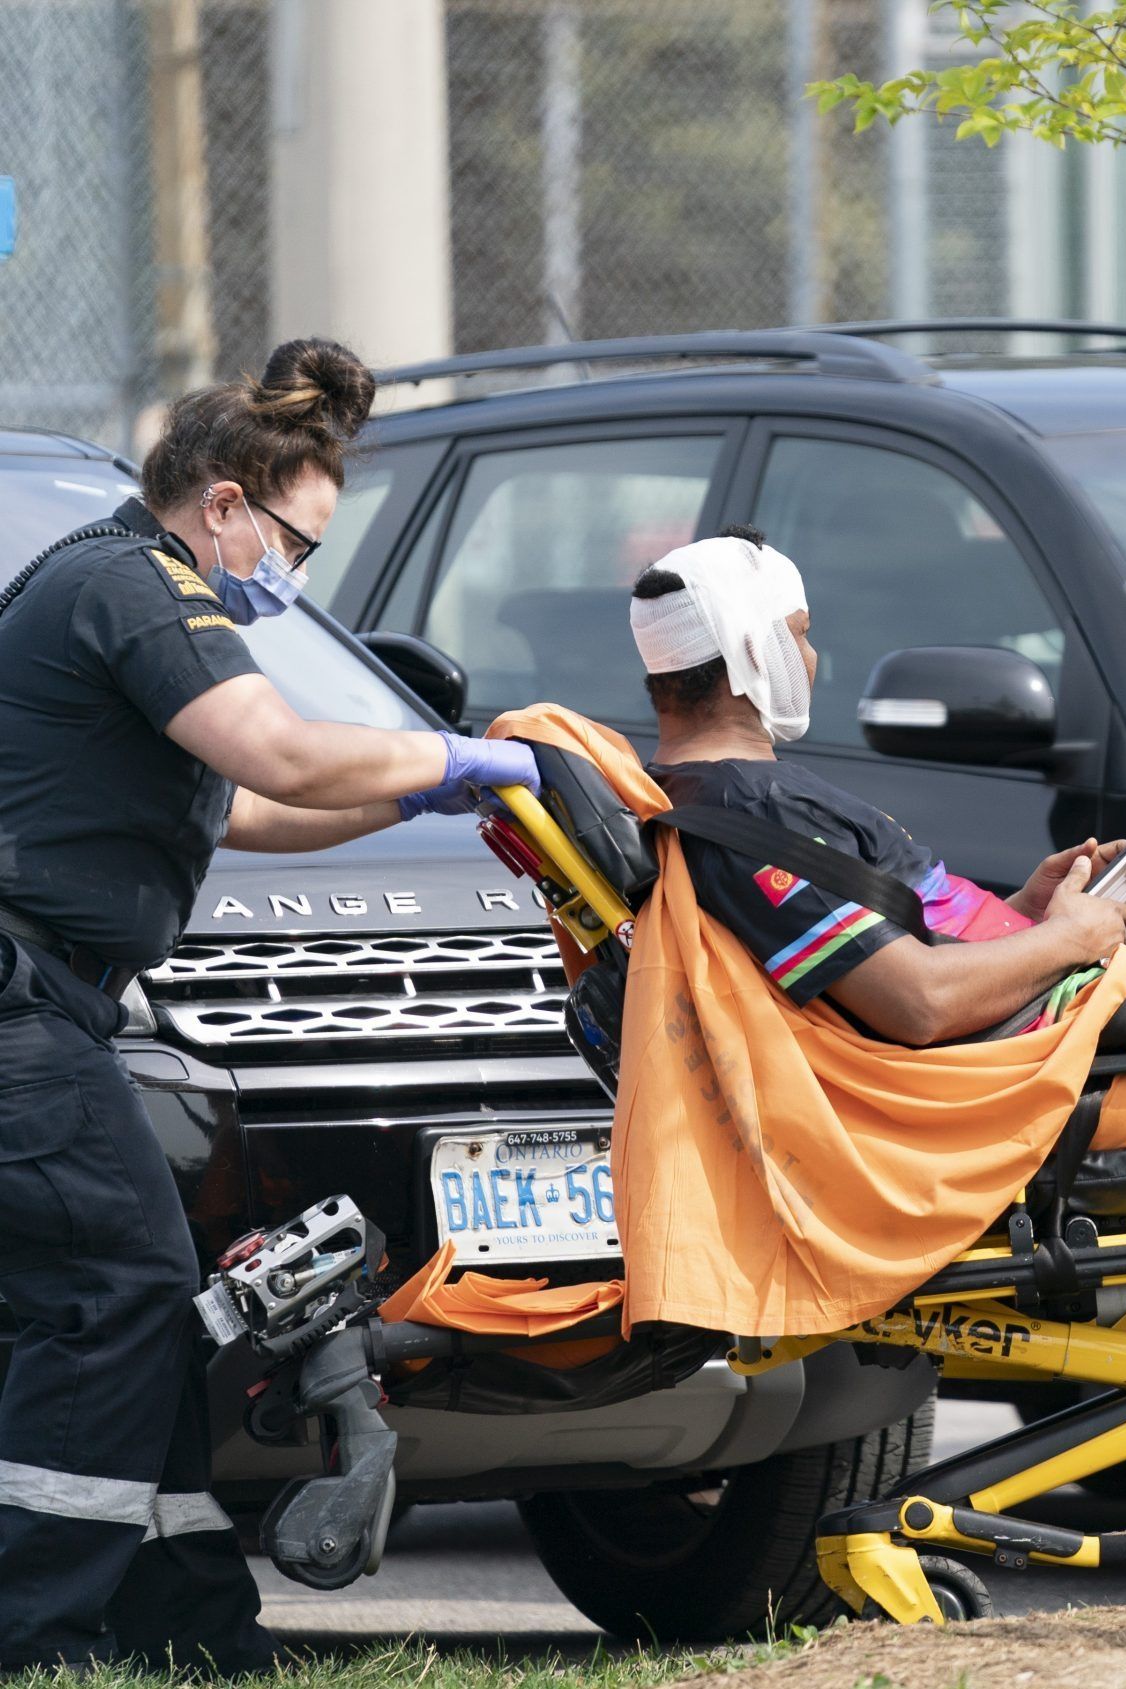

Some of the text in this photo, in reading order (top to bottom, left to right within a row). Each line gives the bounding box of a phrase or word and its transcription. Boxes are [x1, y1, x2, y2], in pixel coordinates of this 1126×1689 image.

[212, 888, 548, 919] ANGE R
[507, 1131, 578, 1145] 647-748-5755
[495, 1143, 583, 1163] ONTARIO
[441, 1167, 543, 1231] BAEK
[496, 1232, 599, 1245] YOURS TO DISCOVER
[846, 1304, 1031, 1357] yker
